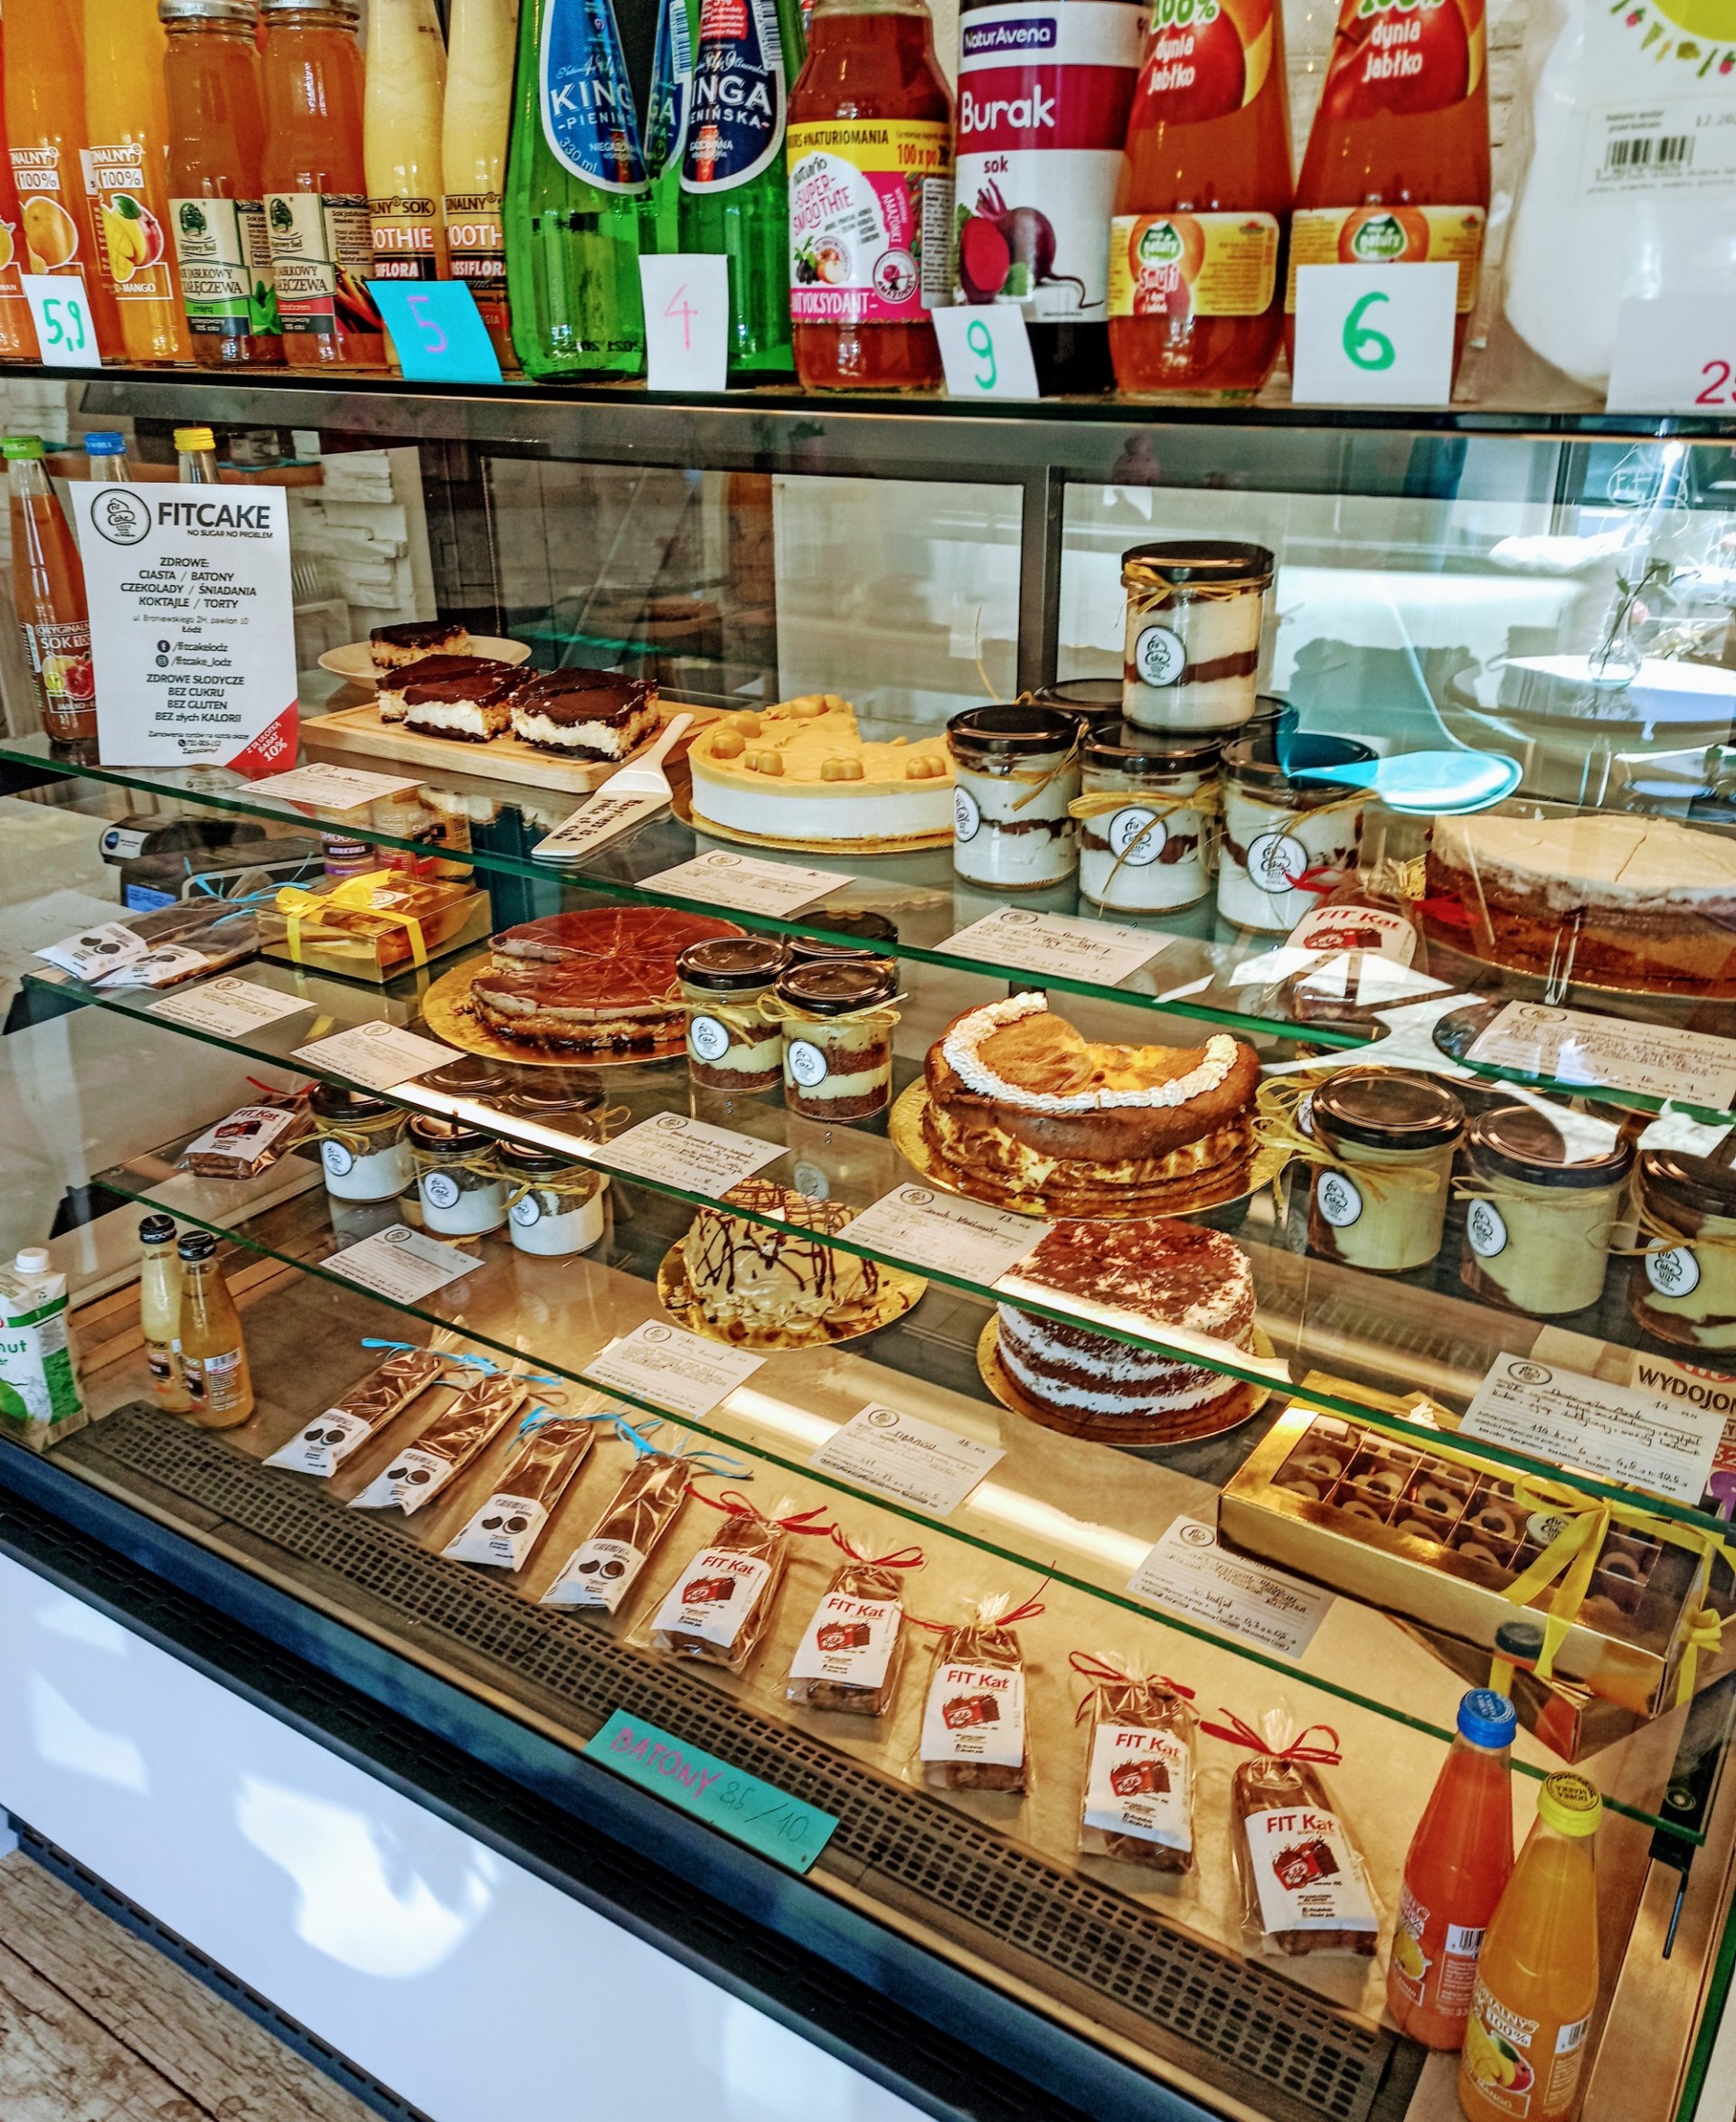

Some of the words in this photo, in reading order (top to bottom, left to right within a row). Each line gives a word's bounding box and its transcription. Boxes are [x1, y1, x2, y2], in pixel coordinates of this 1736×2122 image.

[965, 26, 1051, 50] NaturAvena
[1371, 20, 1420, 47] dynia
[1156, 34, 1194, 61] dynia
[1363, 49, 1422, 83] jabłko
[1148, 65, 1195, 95] jabłko
[960, 84, 1055, 134] Burak
[559, 138, 581, 160] 330
[581, 158, 598, 173] ml
[898, 145, 916, 165] 100
[984, 156, 1008, 173] sok
[20, 173, 58, 188] 100%
[102, 172, 142, 186] 100%
[401, 201, 431, 213] SOK
[408, 296, 448, 353] 5
[664, 284, 698, 351] 4
[1343, 291, 1395, 371] 6
[967, 320, 996, 390] 9
[158, 502, 270, 529] FITCAKE
[139, 571, 175, 580] CIASTA
[191, 572, 234, 582] BATONY
[120, 583, 184, 593] CZEKOLADY
[199, 583, 257, 597] ŚNIADANIA
[139, 597, 190, 608] KOKTAJLE
[204, 599, 239, 608] TORTY
[41, 637, 72, 649] SOK
[146, 674, 191, 684] ZDROWE
[193, 675, 245, 685] SŁODYCZE
[168, 688, 186, 696] BEZ
[189, 688, 224, 697] CUKRU
[167, 701, 184, 709] BEZ
[188, 701, 227, 710] GLUTEN
[156, 712, 174, 721] BEZ
[263, 738, 288, 761] 10%
[1316, 910, 1353, 921] FIT
[1359, 913, 1401, 929] Kat
[702, 1556, 729, 1569] FIT
[728, 1560, 757, 1575] Kat
[826, 1598, 856, 1609] FIT
[856, 1604, 886, 1618] Kat
[947, 1670, 976, 1683] FIT
[978, 1673, 1010, 1689] Kat
[1116, 1733, 1146, 1748] FIT
[1150, 1736, 1182, 1758] Kat
[610, 1728, 723, 1799] BATONY
[1267, 1815, 1297, 1833] FIT
[1303, 1814, 1335, 1831] Kat
